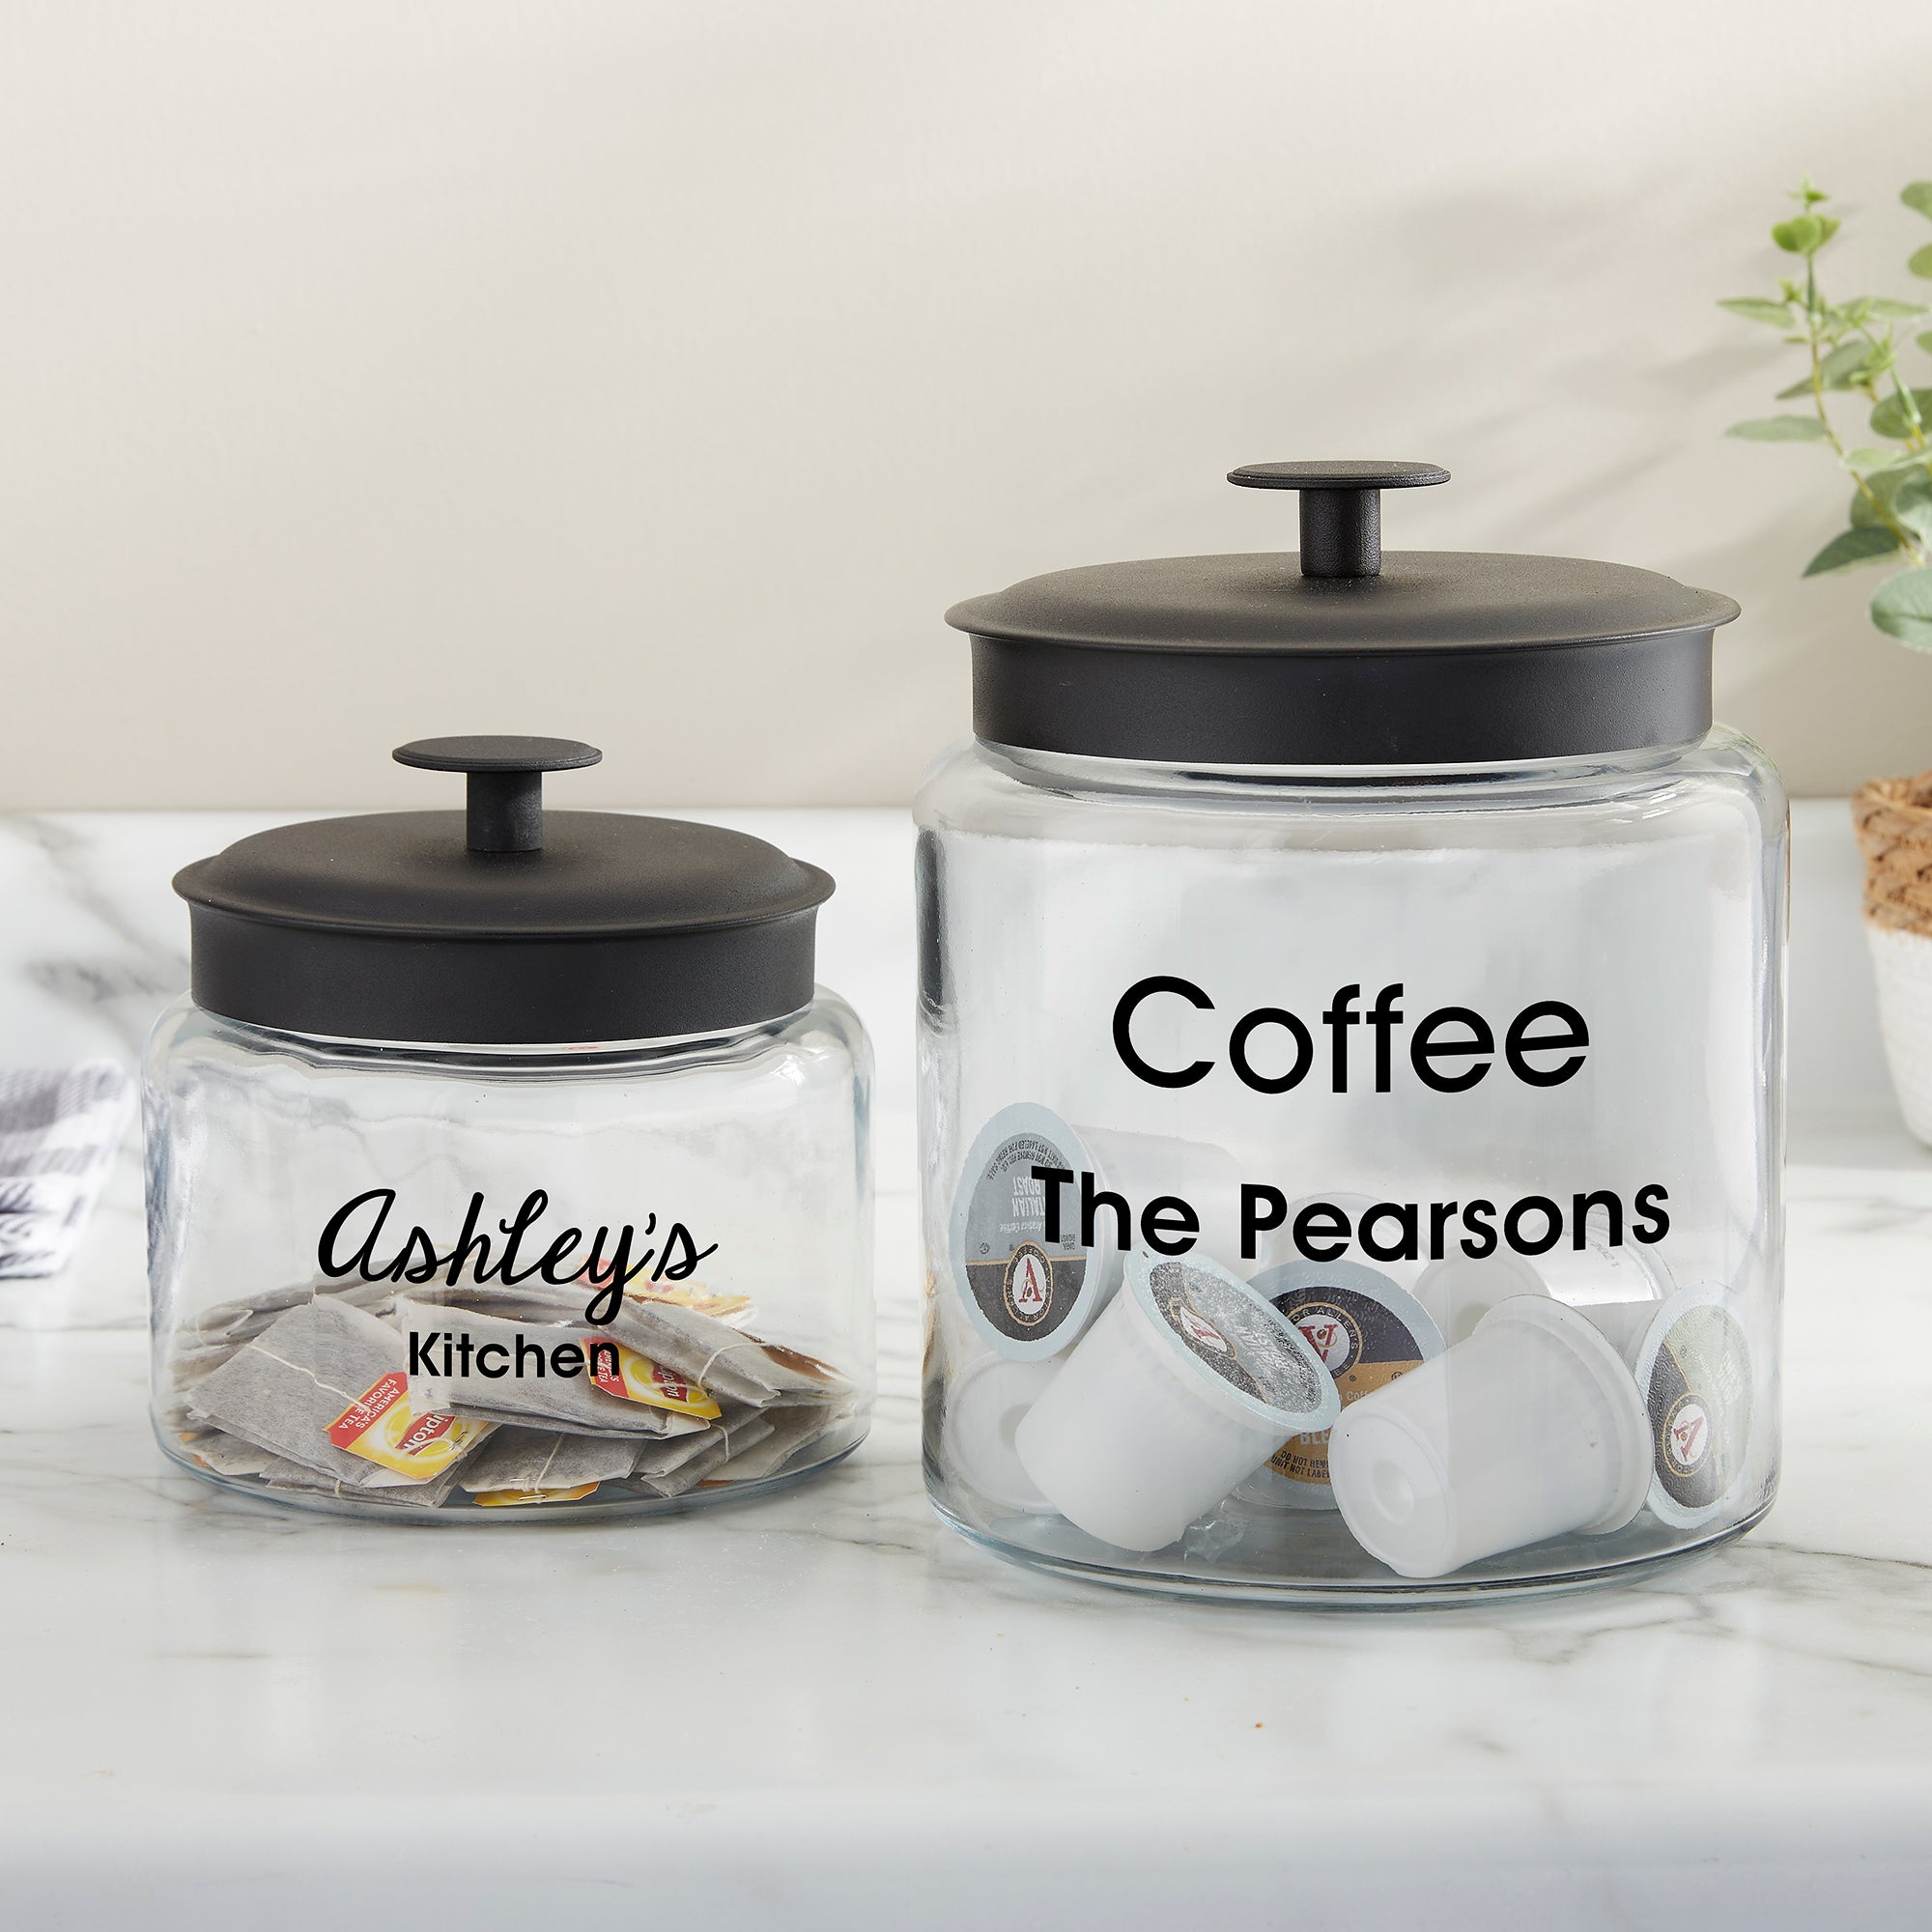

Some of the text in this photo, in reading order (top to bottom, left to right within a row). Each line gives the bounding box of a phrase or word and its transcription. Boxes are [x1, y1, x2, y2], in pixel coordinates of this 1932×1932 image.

[1112, 976, 1589, 1094] Coffee
[1031, 1165, 1670, 1263] The Pearsons
[318, 1188, 719, 1326] Ashley's
[410, 1331, 620, 1378] Kitchen
[338, 1378, 396, 1429] FAVORIE TEA
[355, 1387, 400, 1429] AMERICA'S
[404, 1414, 449, 1451] ipton
[1293, 1455, 1308, 1466] NOT
[1310, 1459, 1329, 1468] REM
